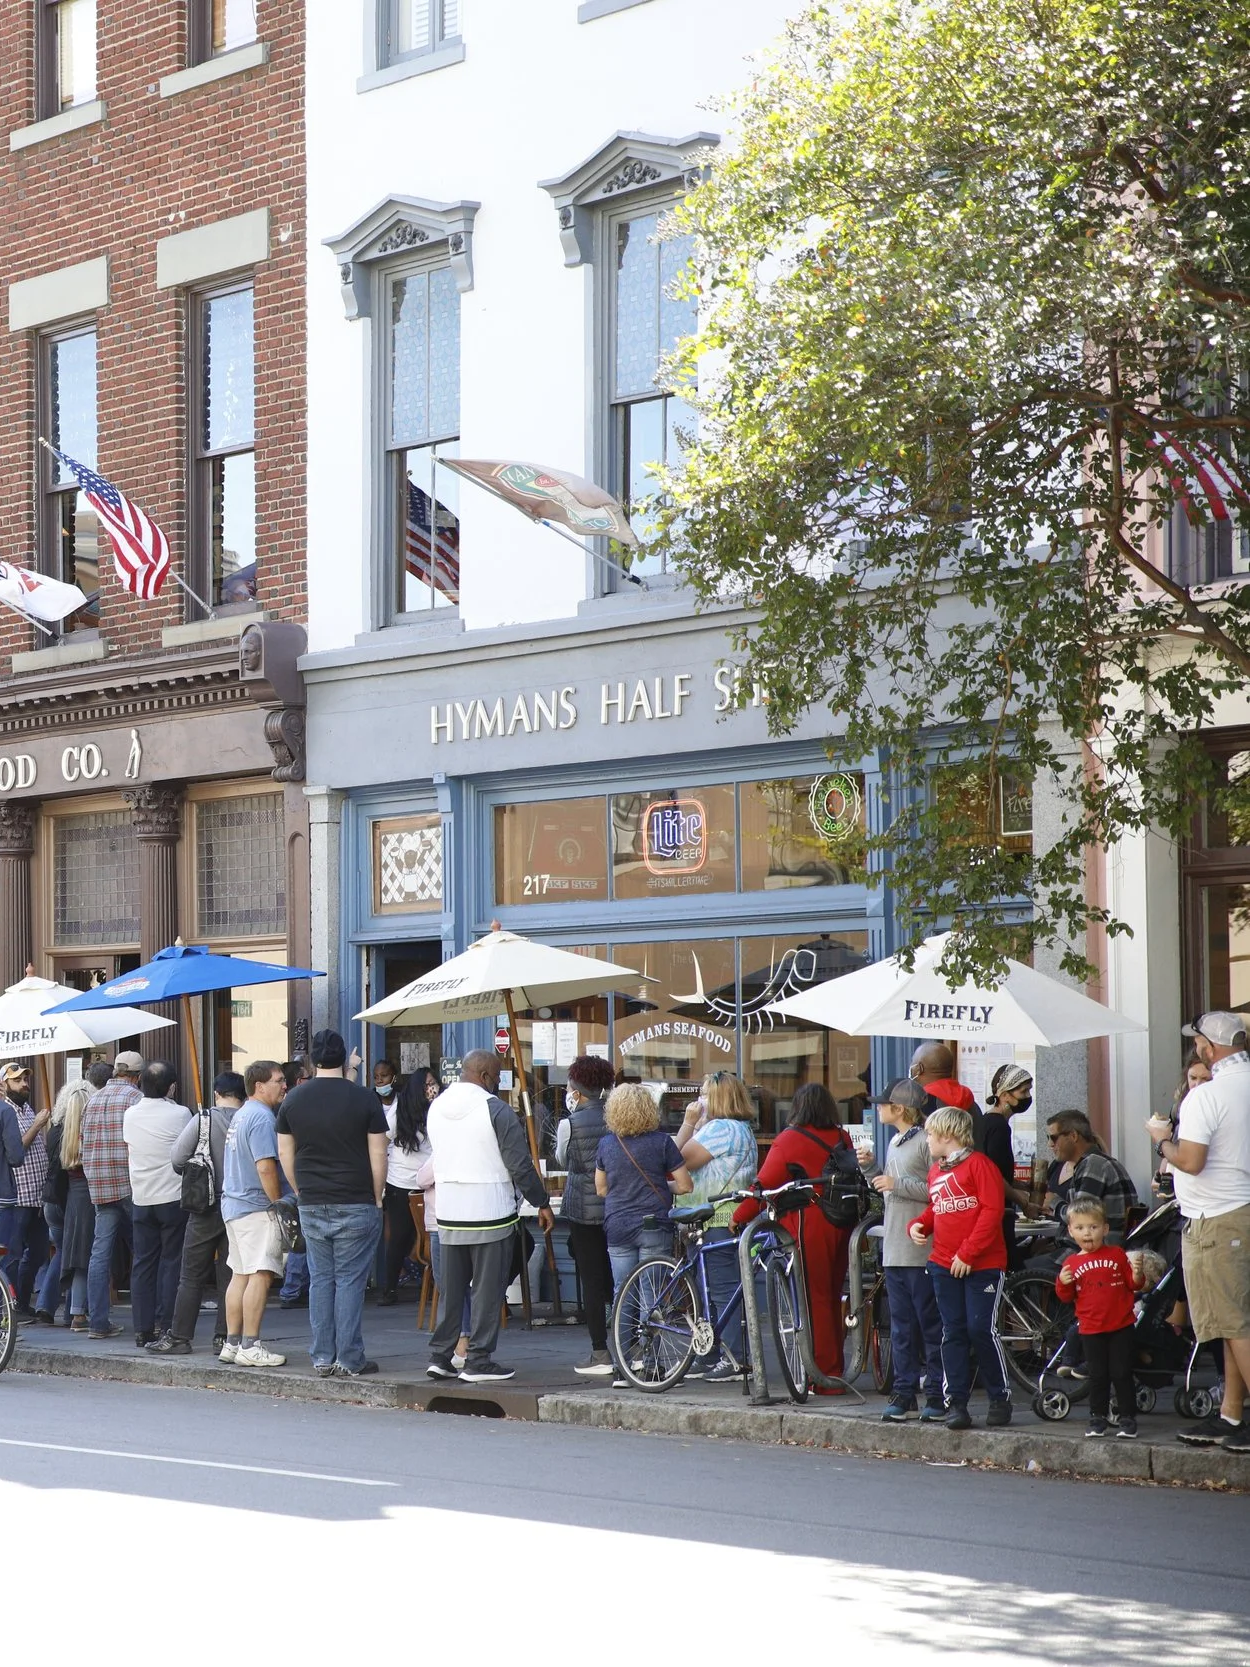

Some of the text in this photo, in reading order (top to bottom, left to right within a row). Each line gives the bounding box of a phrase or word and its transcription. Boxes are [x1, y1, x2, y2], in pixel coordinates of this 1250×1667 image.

[430, 686, 578, 744] HYMANS
[600, 672, 693, 725] HALF
[60, 743, 109, 782] CO.
[652, 809, 703, 857] Lite
[675, 847, 702, 860] BEER
[523, 874, 550, 895] 217
[403, 976, 470, 999] FIREFLY
[904, 1000, 994, 1024] FIREFLY
[911, 1021, 947, 1030] LIGHT
[618, 1022, 671, 1056] HYMANS
[673, 1021, 732, 1053] SEAFOOD
[932, 1196, 979, 1215] didas
[1071, 1259, 1119, 1281] RICERATOPS
